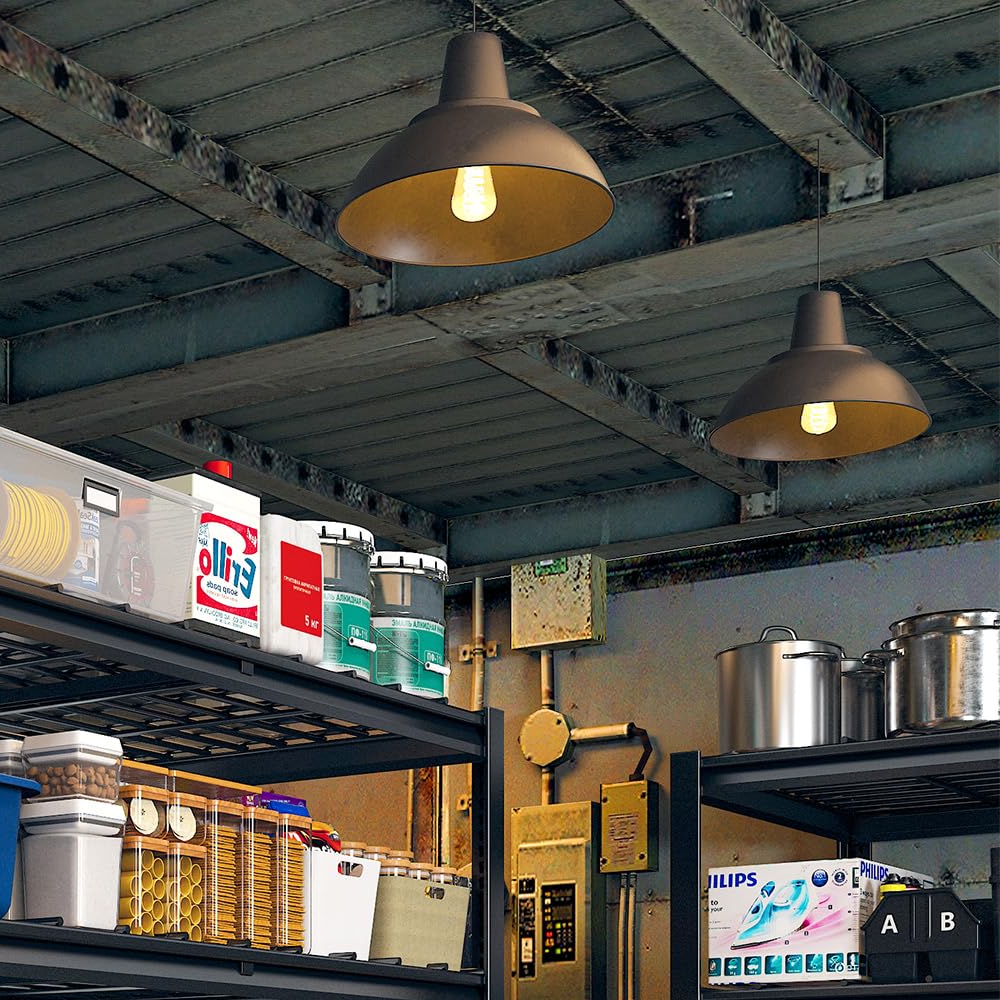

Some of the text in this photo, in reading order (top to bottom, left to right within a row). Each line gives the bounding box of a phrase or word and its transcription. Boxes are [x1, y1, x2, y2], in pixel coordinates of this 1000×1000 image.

[304, 614, 320, 630] 5 кг
[860, 860, 889, 882] PHILIPS
[880, 913, 899, 935] A
[940, 910, 956, 931] B
